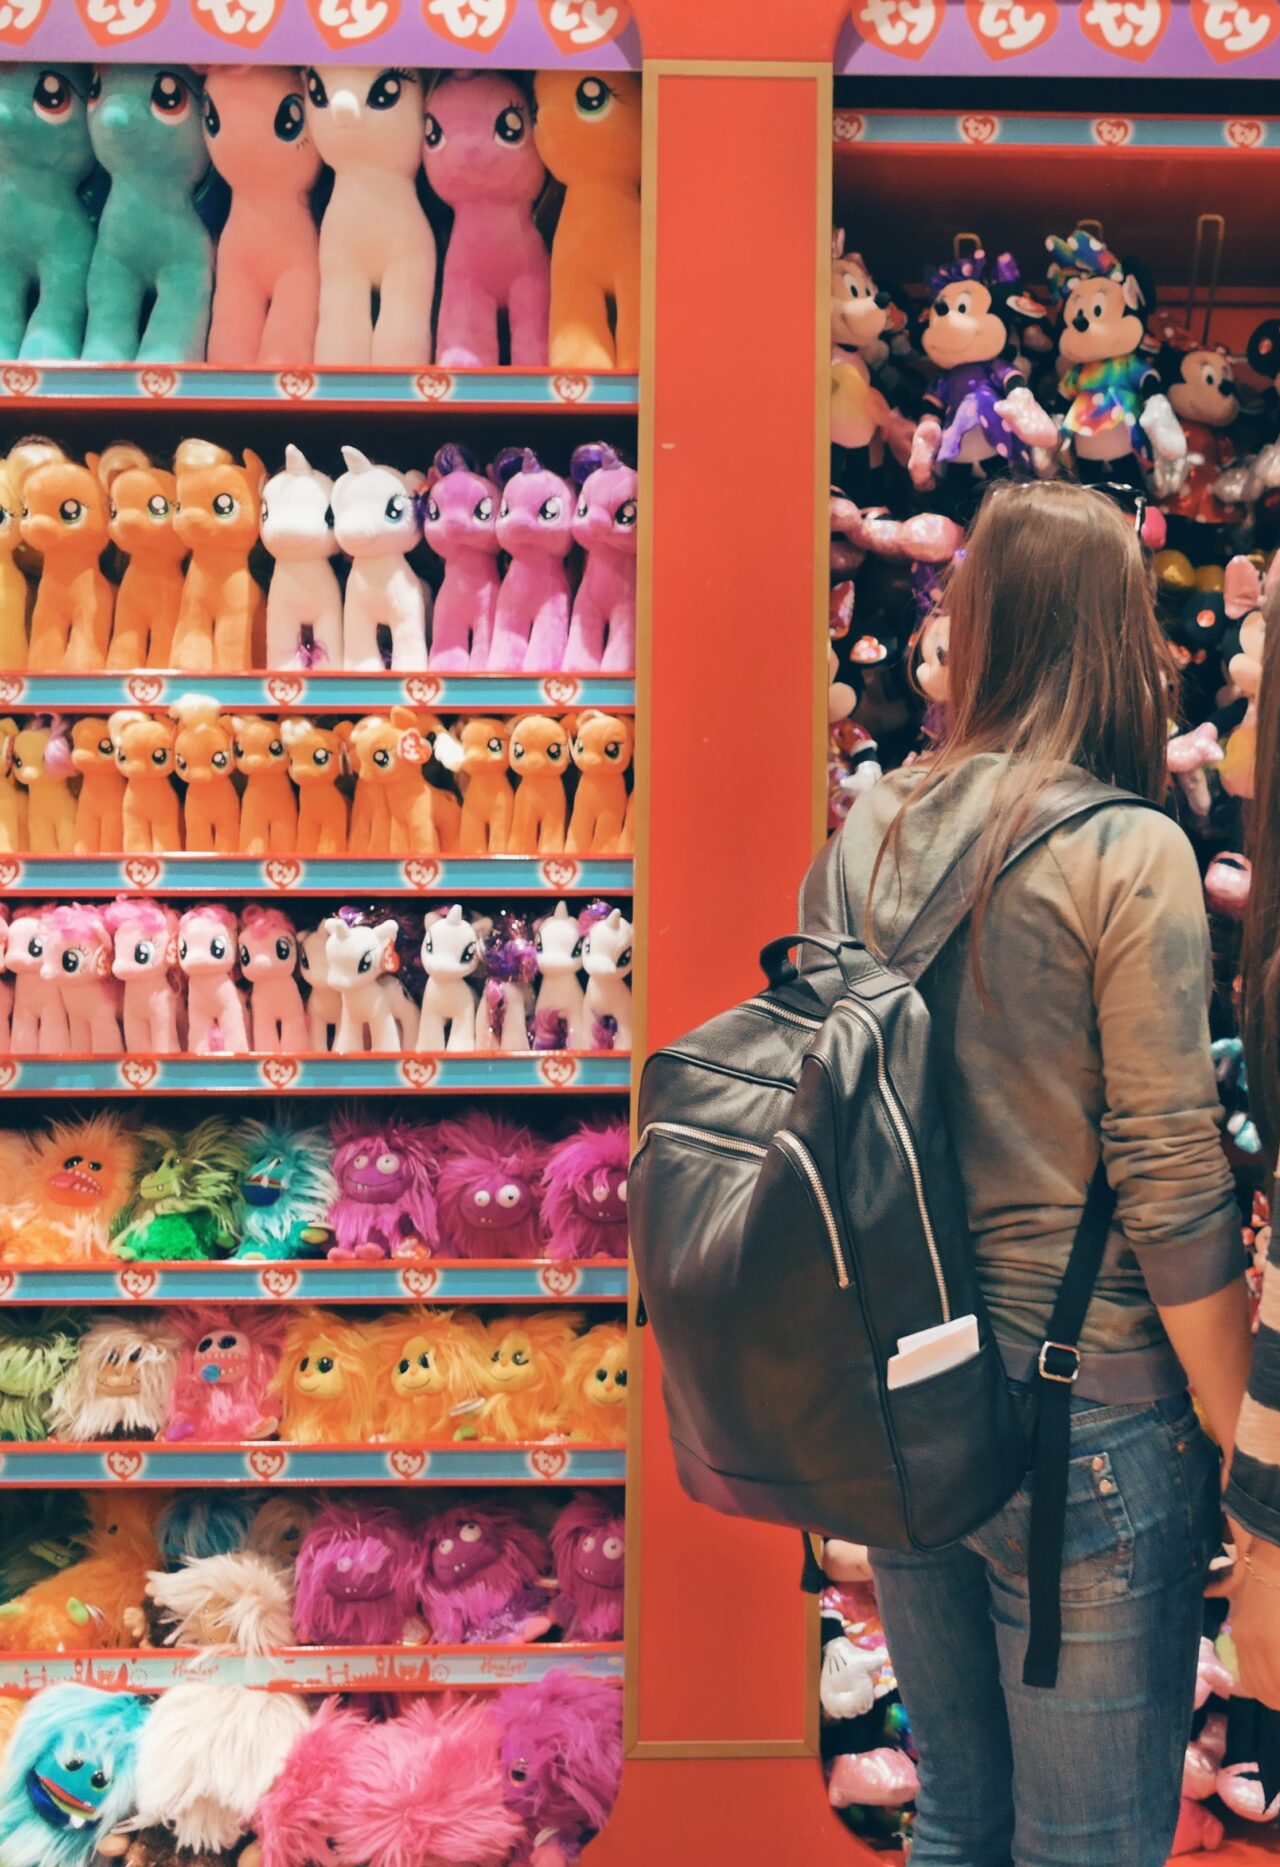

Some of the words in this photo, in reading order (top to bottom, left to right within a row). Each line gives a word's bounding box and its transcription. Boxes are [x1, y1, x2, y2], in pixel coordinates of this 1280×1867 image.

[0, 0, 41, 29] y
[428, 0, 506, 38] ty
[550, 0, 618, 44] ty
[860, 0, 936, 45] ty
[978, 0, 1046, 49] ty
[1085, 0, 1161, 47] ty
[1202, 0, 1271, 51] ty
[5, 370, 33, 392] ty
[144, 371, 172, 393] ty
[282, 373, 310, 395] ty
[419, 374, 447, 396] ty
[556, 375, 584, 397] ty
[131, 677, 158, 699] ty
[270, 678, 297, 700] ty
[408, 678, 435, 700] ty
[546, 678, 573, 700] ty
[128, 861, 155, 883] ty
[268, 861, 295, 883] ty
[407, 861, 434, 883] ty
[545, 861, 572, 883] ty
[125, 1060, 152, 1082] ty
[266, 1060, 293, 1082] ty
[405, 1060, 432, 1082] ty
[544, 1059, 571, 1081] ty
[123, 1270, 150, 1292] ty
[265, 1270, 292, 1292] ty
[405, 1269, 432, 1291] ty
[545, 1268, 572, 1290] ty
